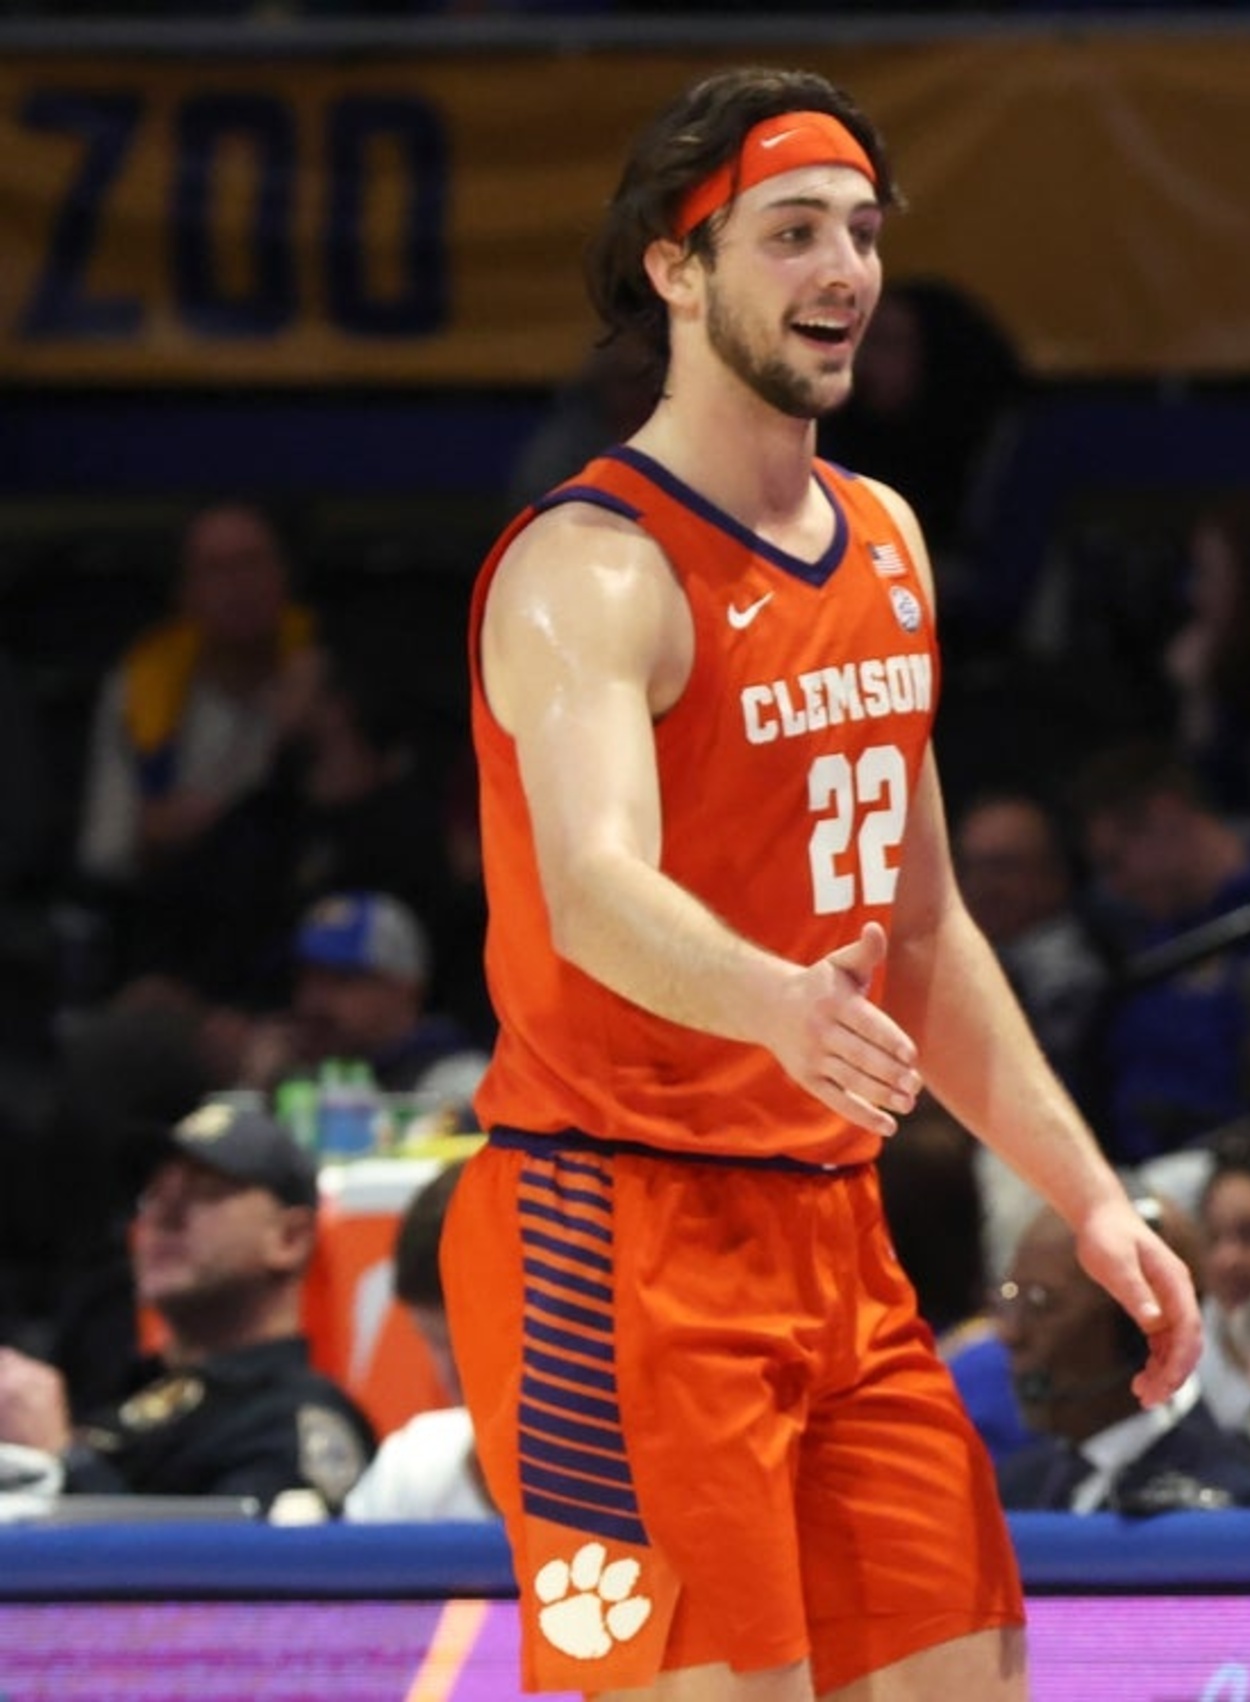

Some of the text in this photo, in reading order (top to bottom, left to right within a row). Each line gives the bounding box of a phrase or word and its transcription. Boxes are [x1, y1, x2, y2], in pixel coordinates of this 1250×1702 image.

[17, 91, 451, 339] ZOO
[741, 653, 931, 744] CLEMSON
[808, 745, 907, 914] 22
